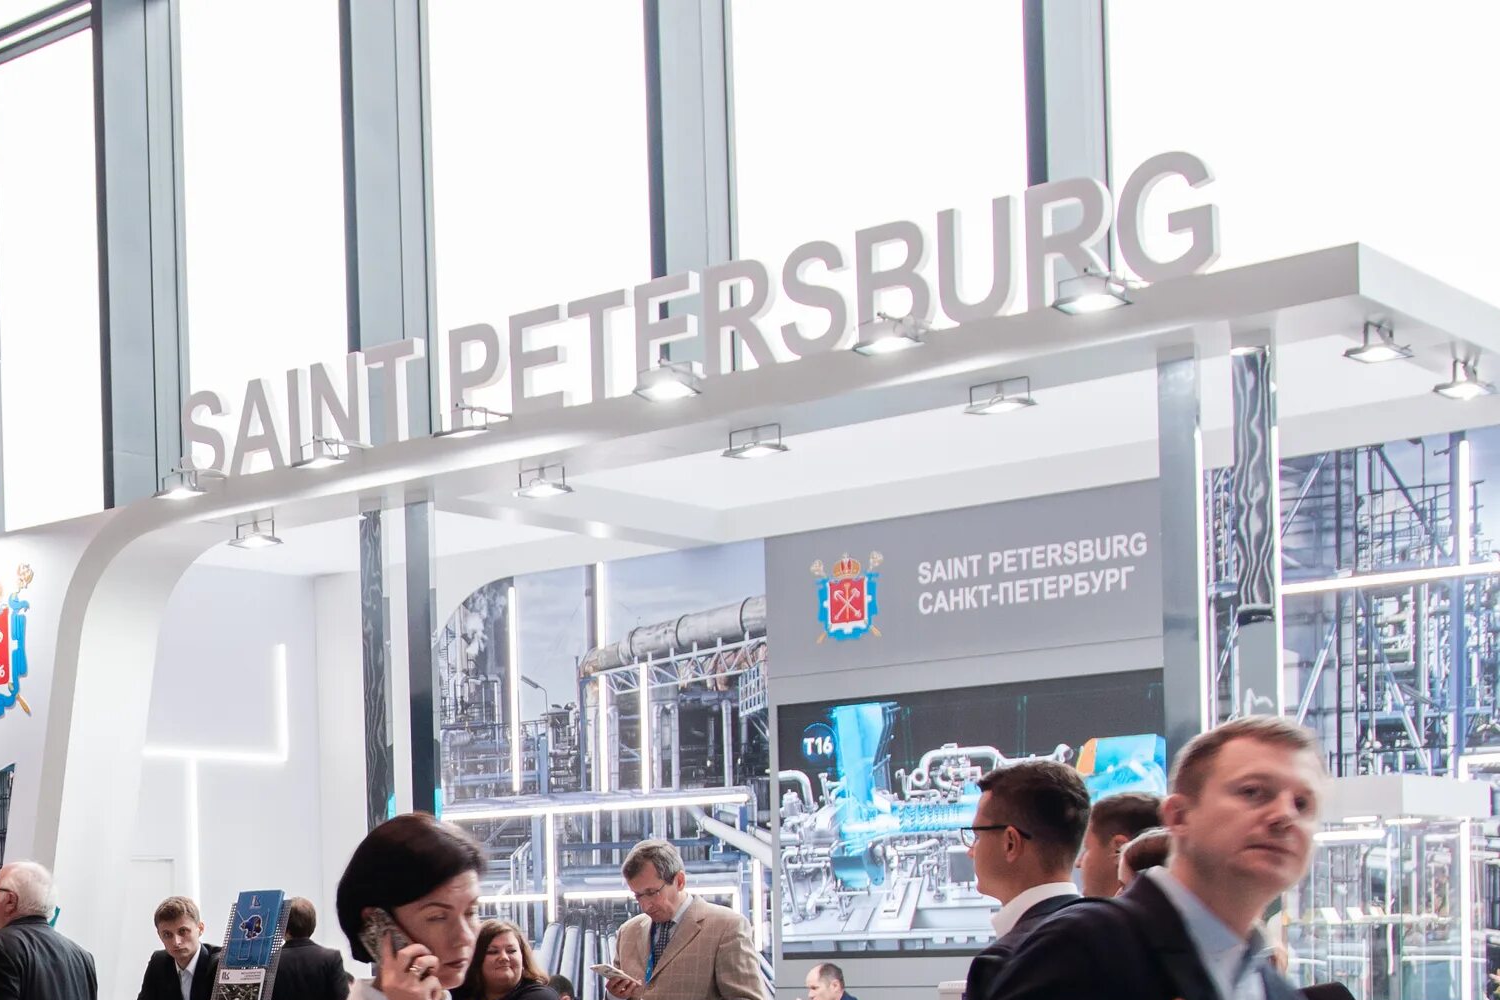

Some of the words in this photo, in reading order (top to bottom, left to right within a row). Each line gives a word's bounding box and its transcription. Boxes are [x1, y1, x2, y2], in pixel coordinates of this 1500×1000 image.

[182, 337, 426, 475] SAINT
[450, 150, 1216, 434] PETERSBURG
[918, 554, 982, 584] SAINT
[988, 531, 1148, 575] PETERSBURG
[918, 566, 1135, 615] САНКТ-ПЕТЕРБУРГ
[803, 736, 834, 756] T16
